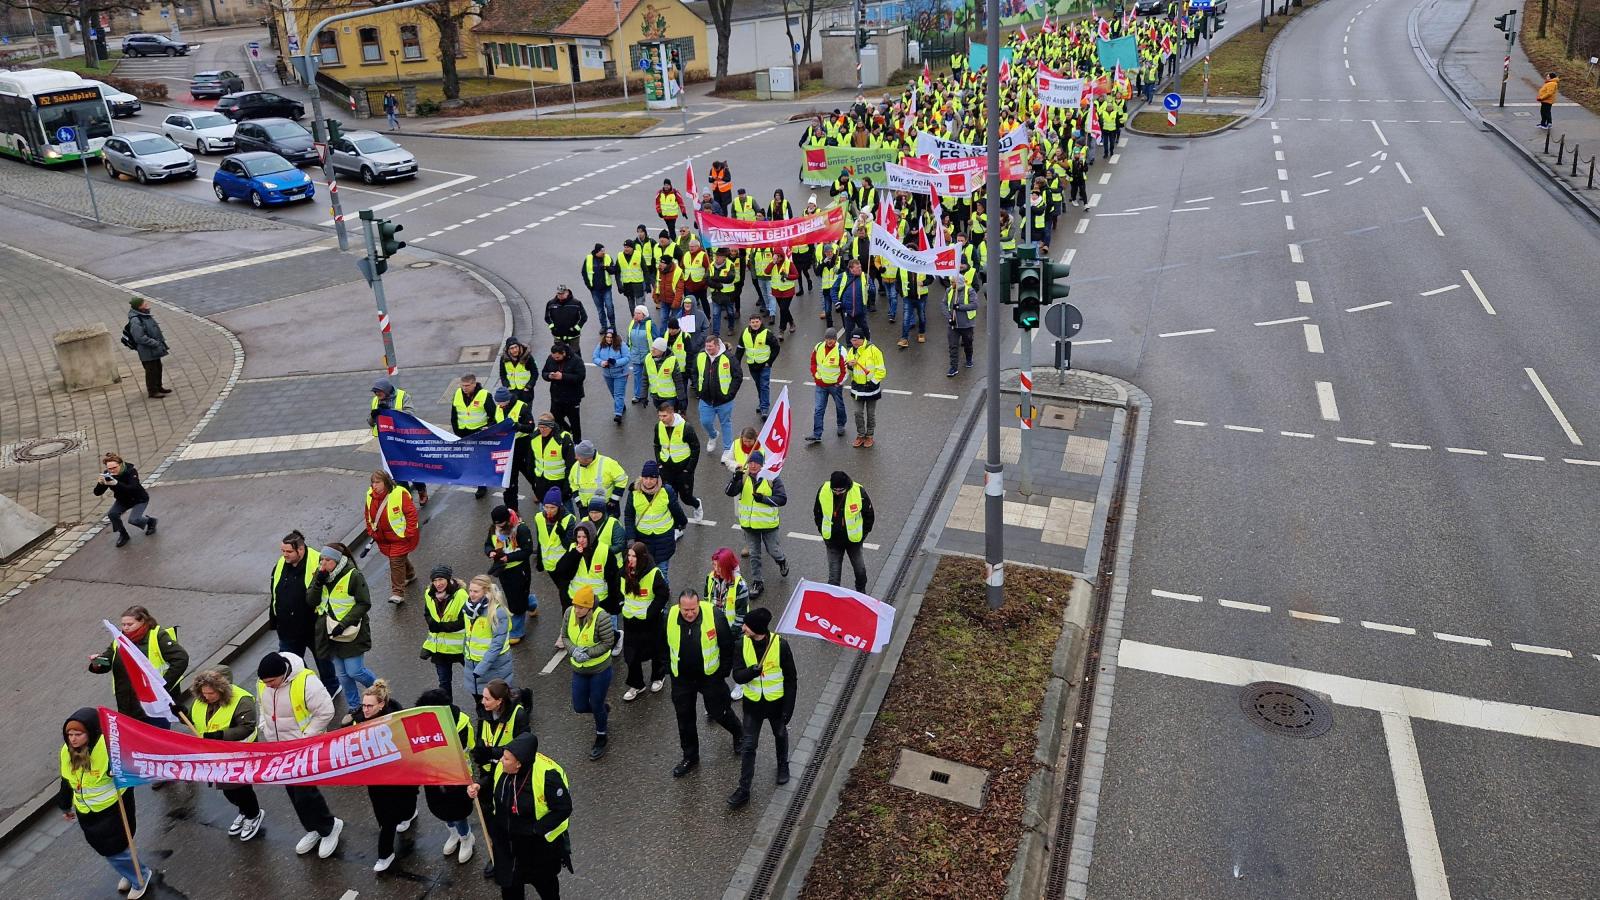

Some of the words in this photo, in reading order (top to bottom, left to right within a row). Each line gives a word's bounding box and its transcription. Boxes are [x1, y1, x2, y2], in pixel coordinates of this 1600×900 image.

[1053, 96, 1077, 105] Ansbach
[850, 153, 892, 164] Spannung
[889, 174, 904, 183] Wir
[709, 230, 764, 243] ZUSAMMEN
[766, 225, 796, 240] GEHT
[875, 237, 890, 251] Wir
[891, 248, 928, 266] streiken
[133, 758, 262, 783] ZUSAMMEN
[260, 742, 324, 782] GEHT
[329, 723, 399, 769] MEHR
